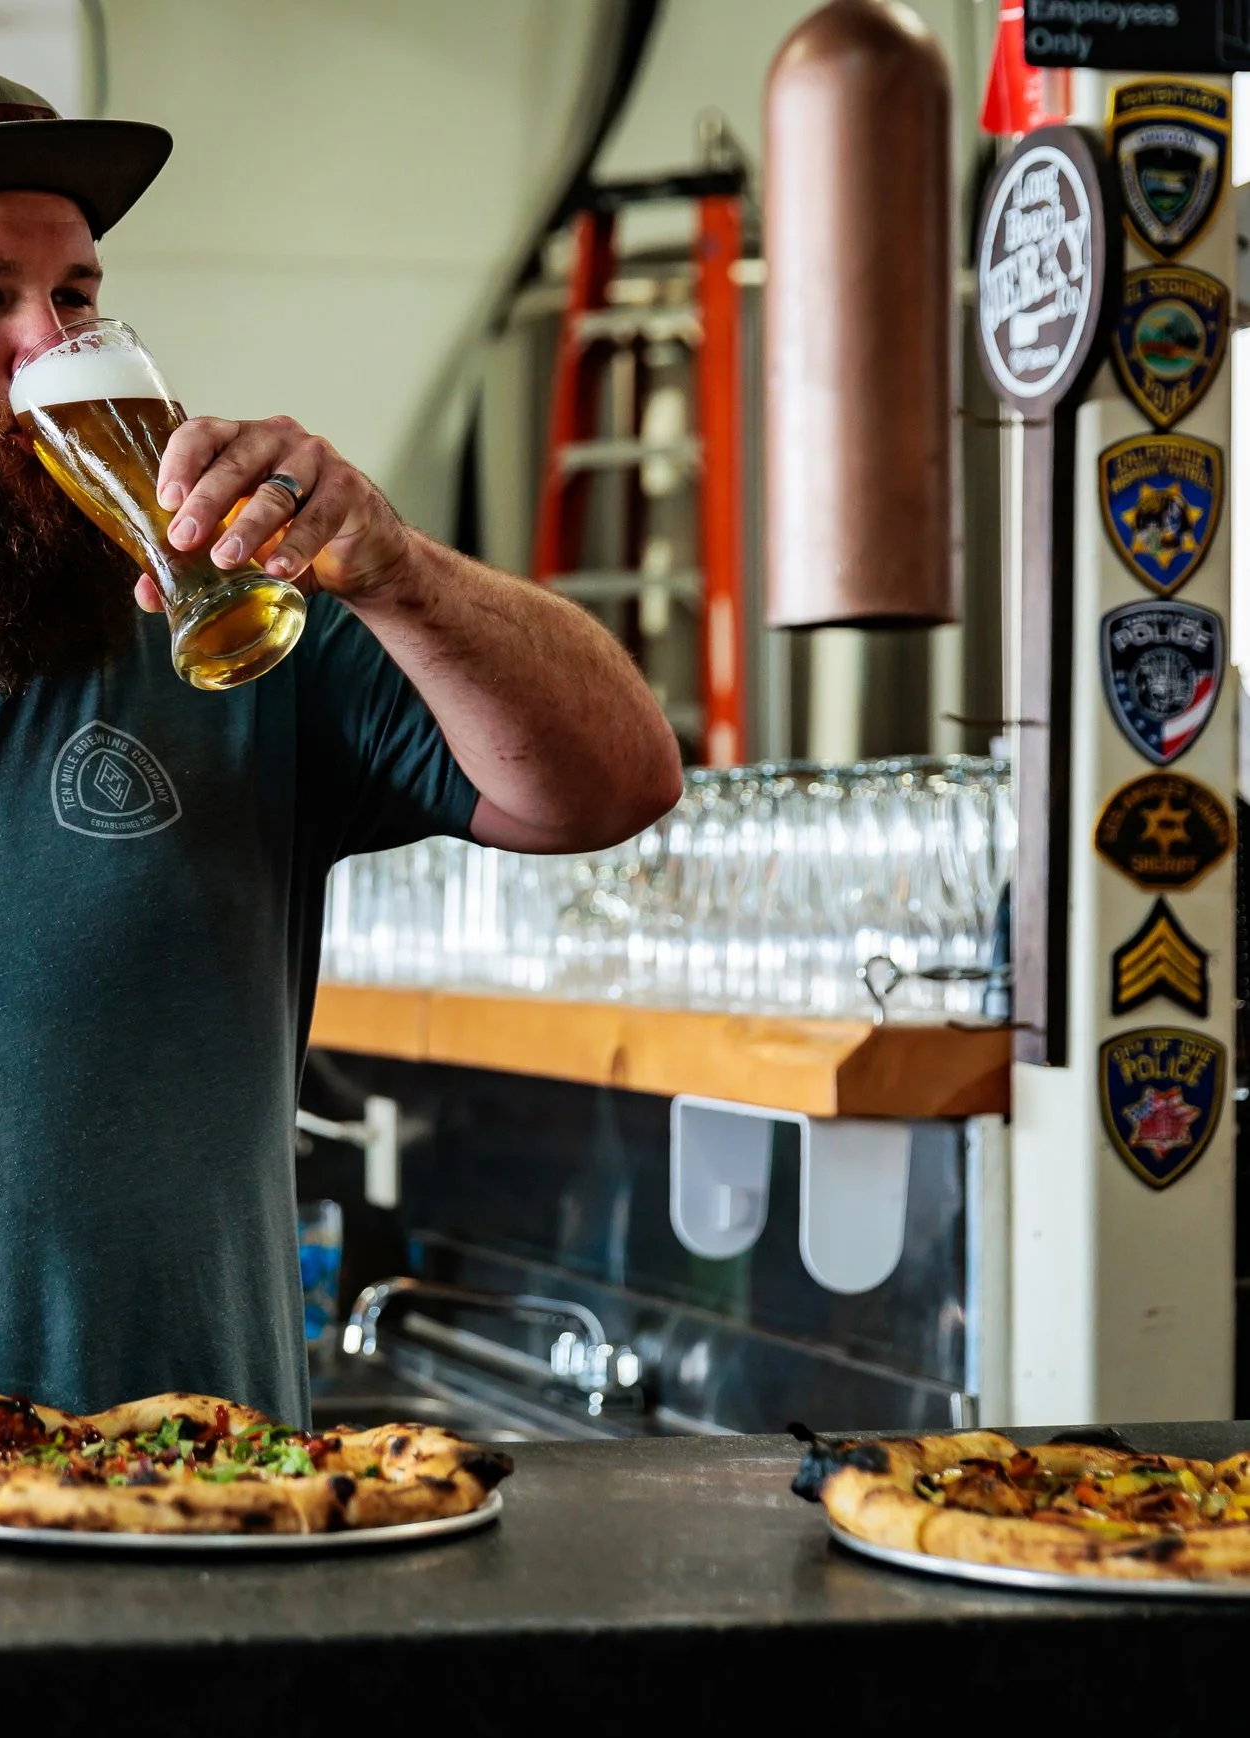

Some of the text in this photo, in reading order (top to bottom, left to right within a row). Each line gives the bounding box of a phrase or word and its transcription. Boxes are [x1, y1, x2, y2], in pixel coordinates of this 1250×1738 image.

[1029, 0, 1179, 29] Employees
[1029, 28, 1092, 60] Only
[1004, 203, 1066, 252] Beach
[1146, 276, 1217, 311] SEGUNDO
[1112, 622, 1213, 652] POLICE
[61, 732, 170, 810] TEN MILE BREWING COMPANY
[90, 818, 141, 830] ESTABLISHED
[1130, 855, 1198, 873] SHERIFF
[1151, 1037, 1171, 1051] OF
[1118, 1054, 1209, 1087] POLICE
